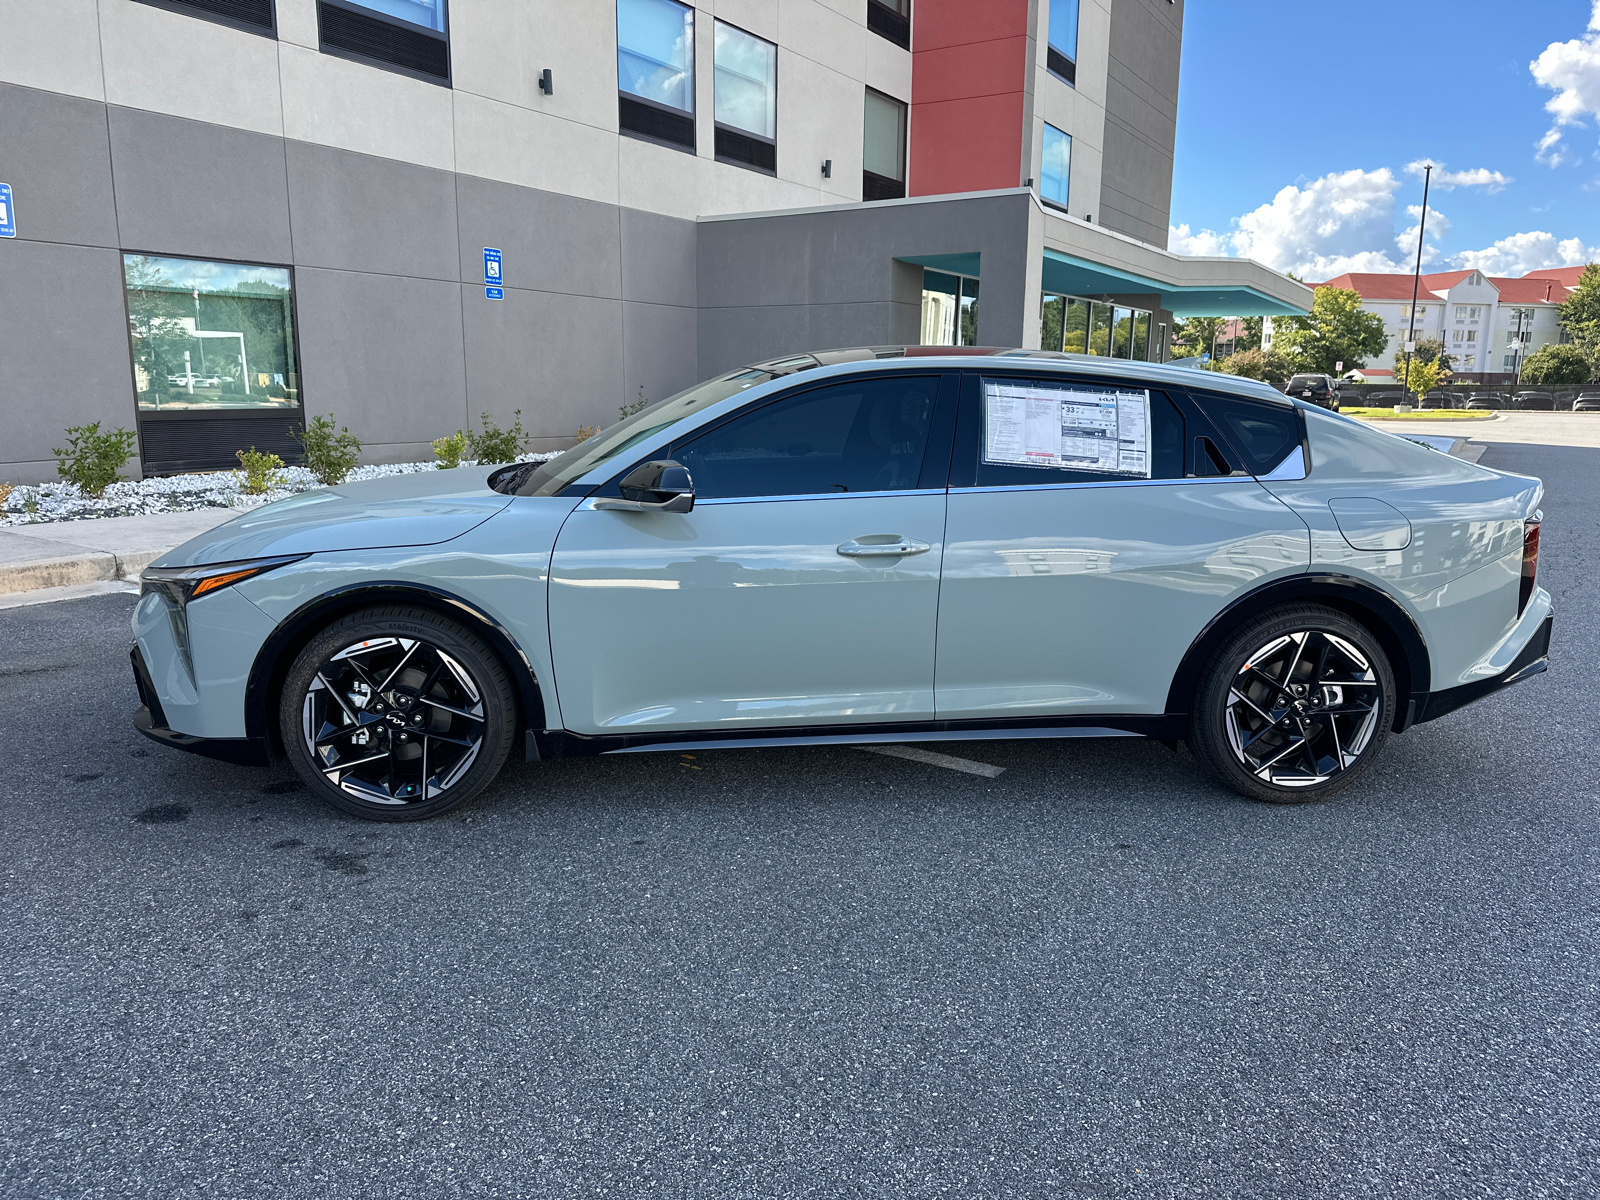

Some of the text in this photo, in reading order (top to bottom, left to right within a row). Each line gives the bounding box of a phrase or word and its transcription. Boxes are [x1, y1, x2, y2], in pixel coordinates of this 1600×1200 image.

[1270, 625, 1284, 634] R18
[385, 714, 406, 726] KIA
[1378, 694, 1392, 742] KUMHO
